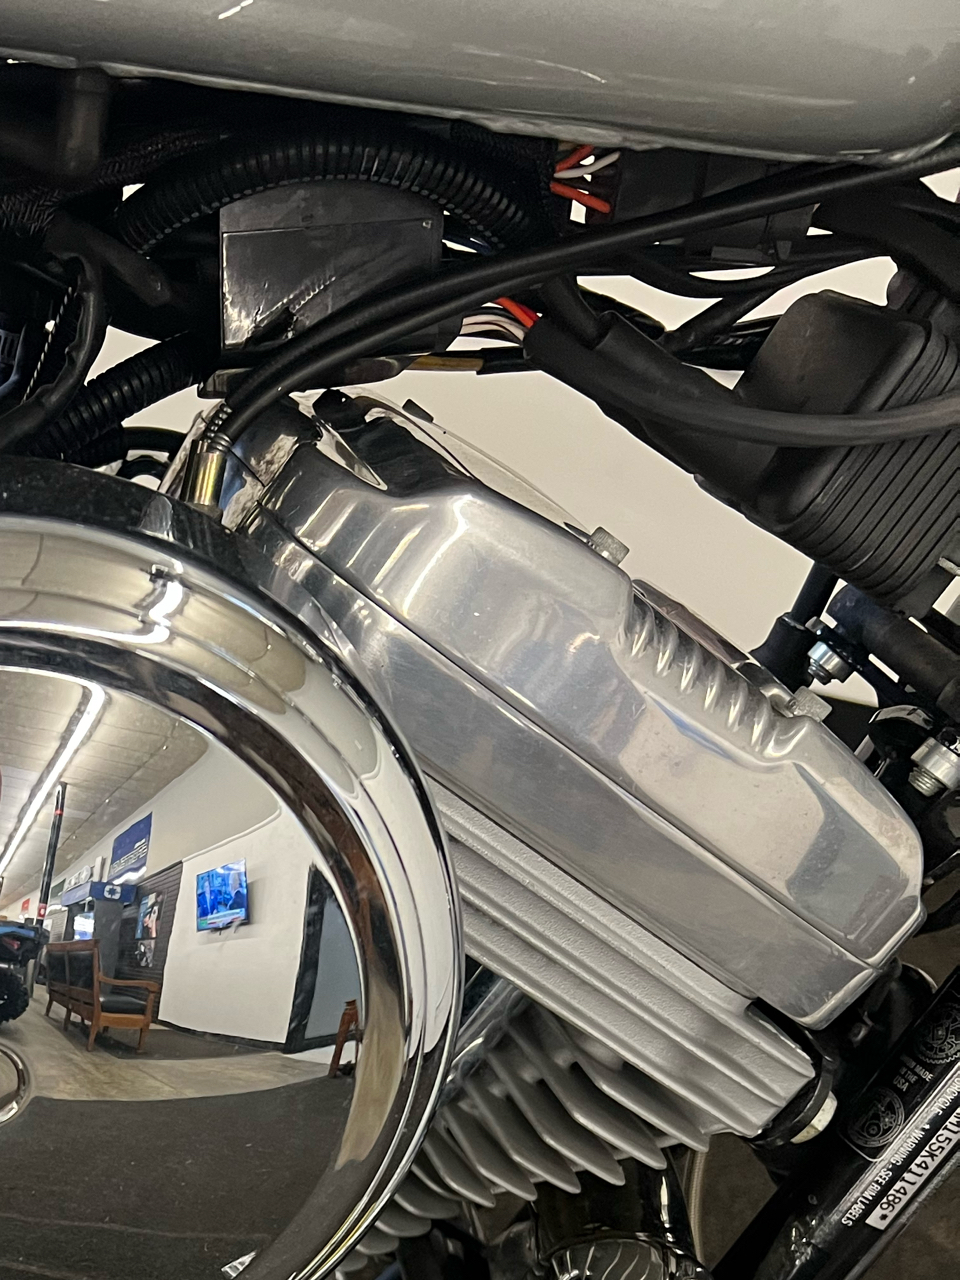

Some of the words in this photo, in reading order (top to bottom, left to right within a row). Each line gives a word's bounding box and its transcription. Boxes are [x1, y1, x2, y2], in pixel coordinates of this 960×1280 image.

[893, 1075, 909, 1092] USA
[905, 1070, 919, 1084] THE
[891, 1128, 926, 1166] WARNING
[874, 1168, 893, 1186] SEE
[862, 1182, 881, 1200] RIM
[841, 1197, 870, 1227] LABELS
